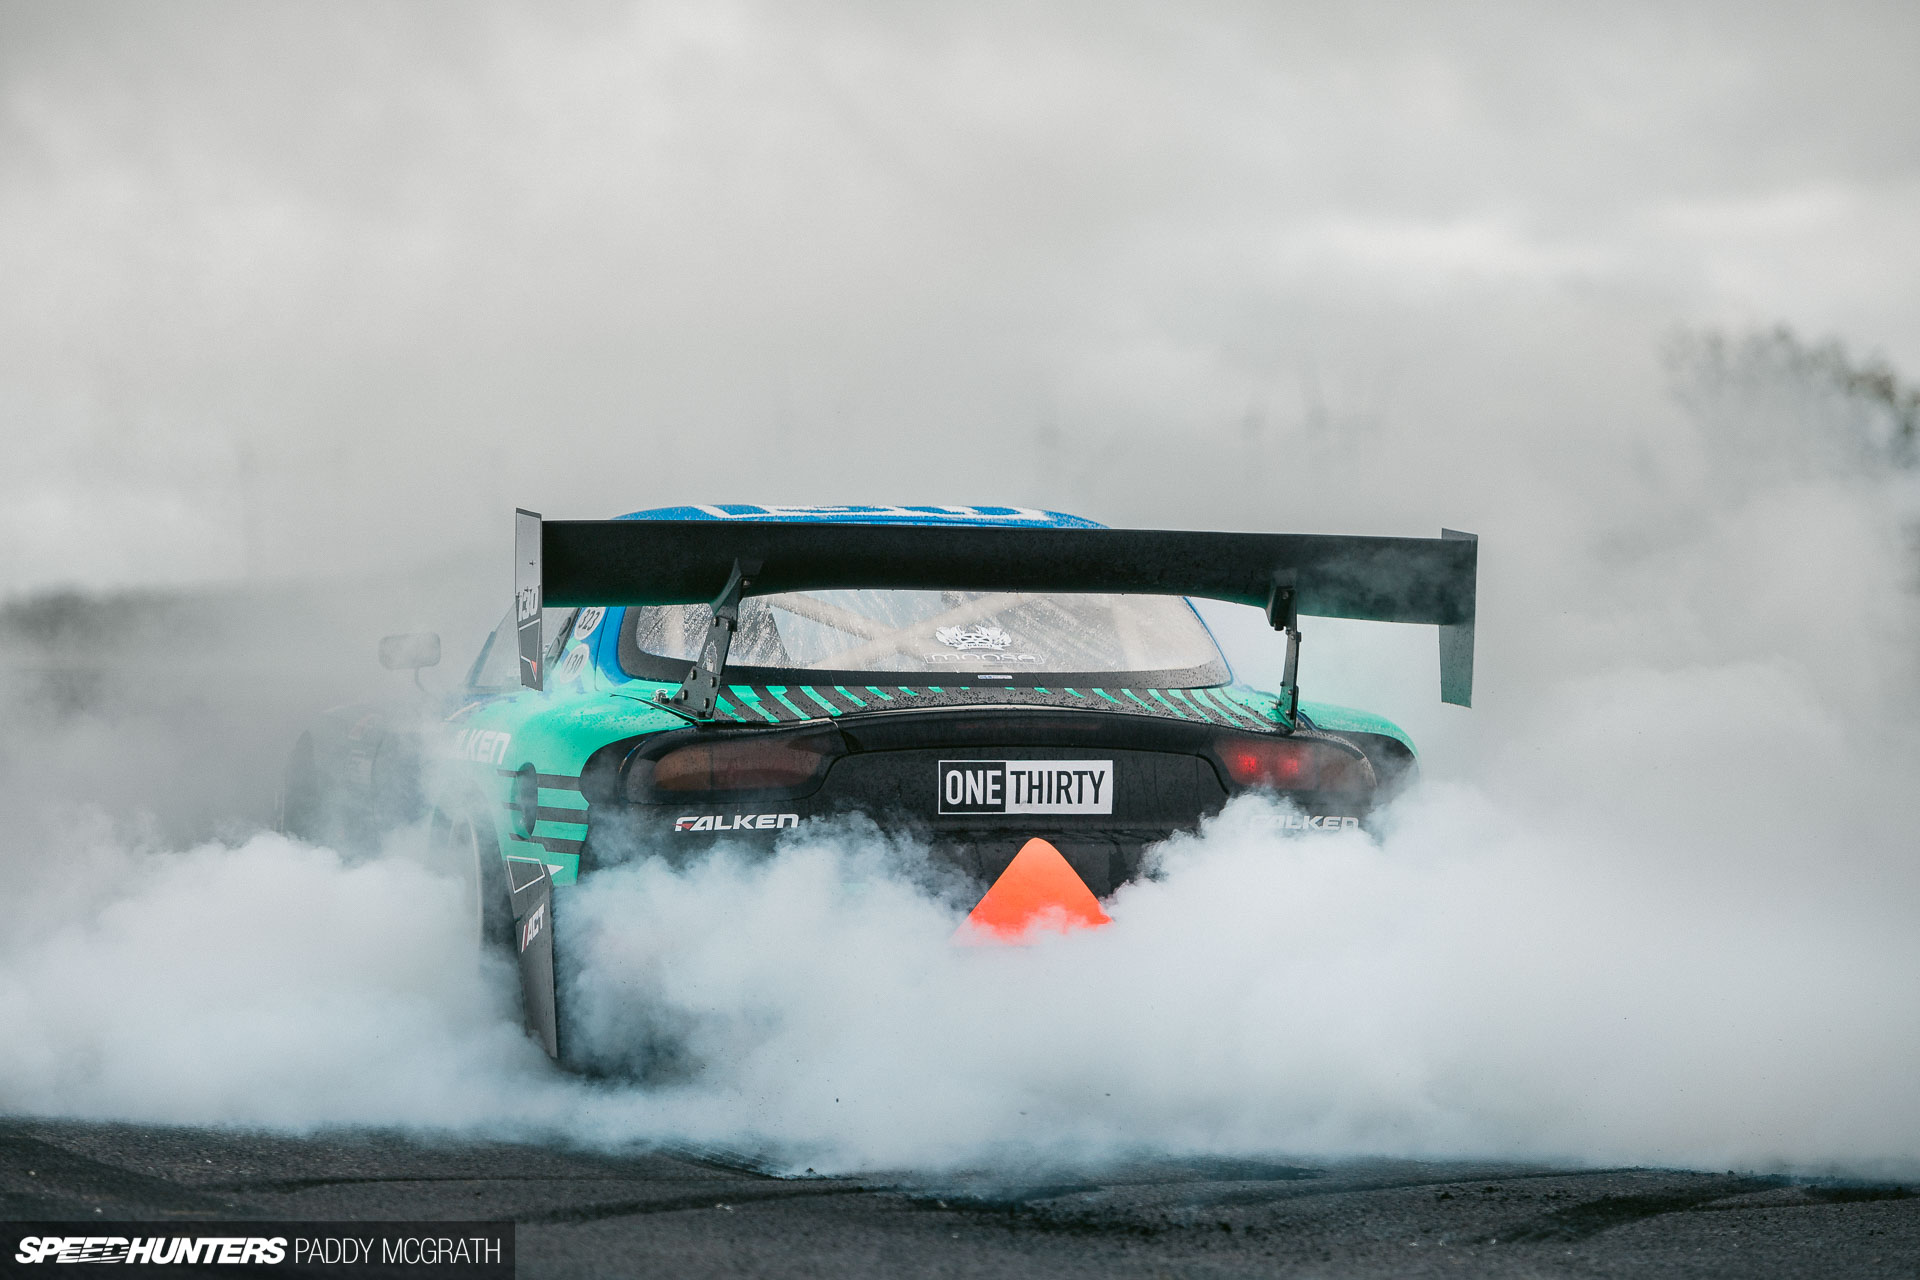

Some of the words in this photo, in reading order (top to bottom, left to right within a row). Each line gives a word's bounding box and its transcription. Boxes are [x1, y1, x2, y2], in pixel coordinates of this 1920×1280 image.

[578, 608, 600, 631] 323
[945, 769, 1002, 805] ONE
[1009, 770, 1105, 805] THIRTY
[673, 813, 800, 832] FALKEN
